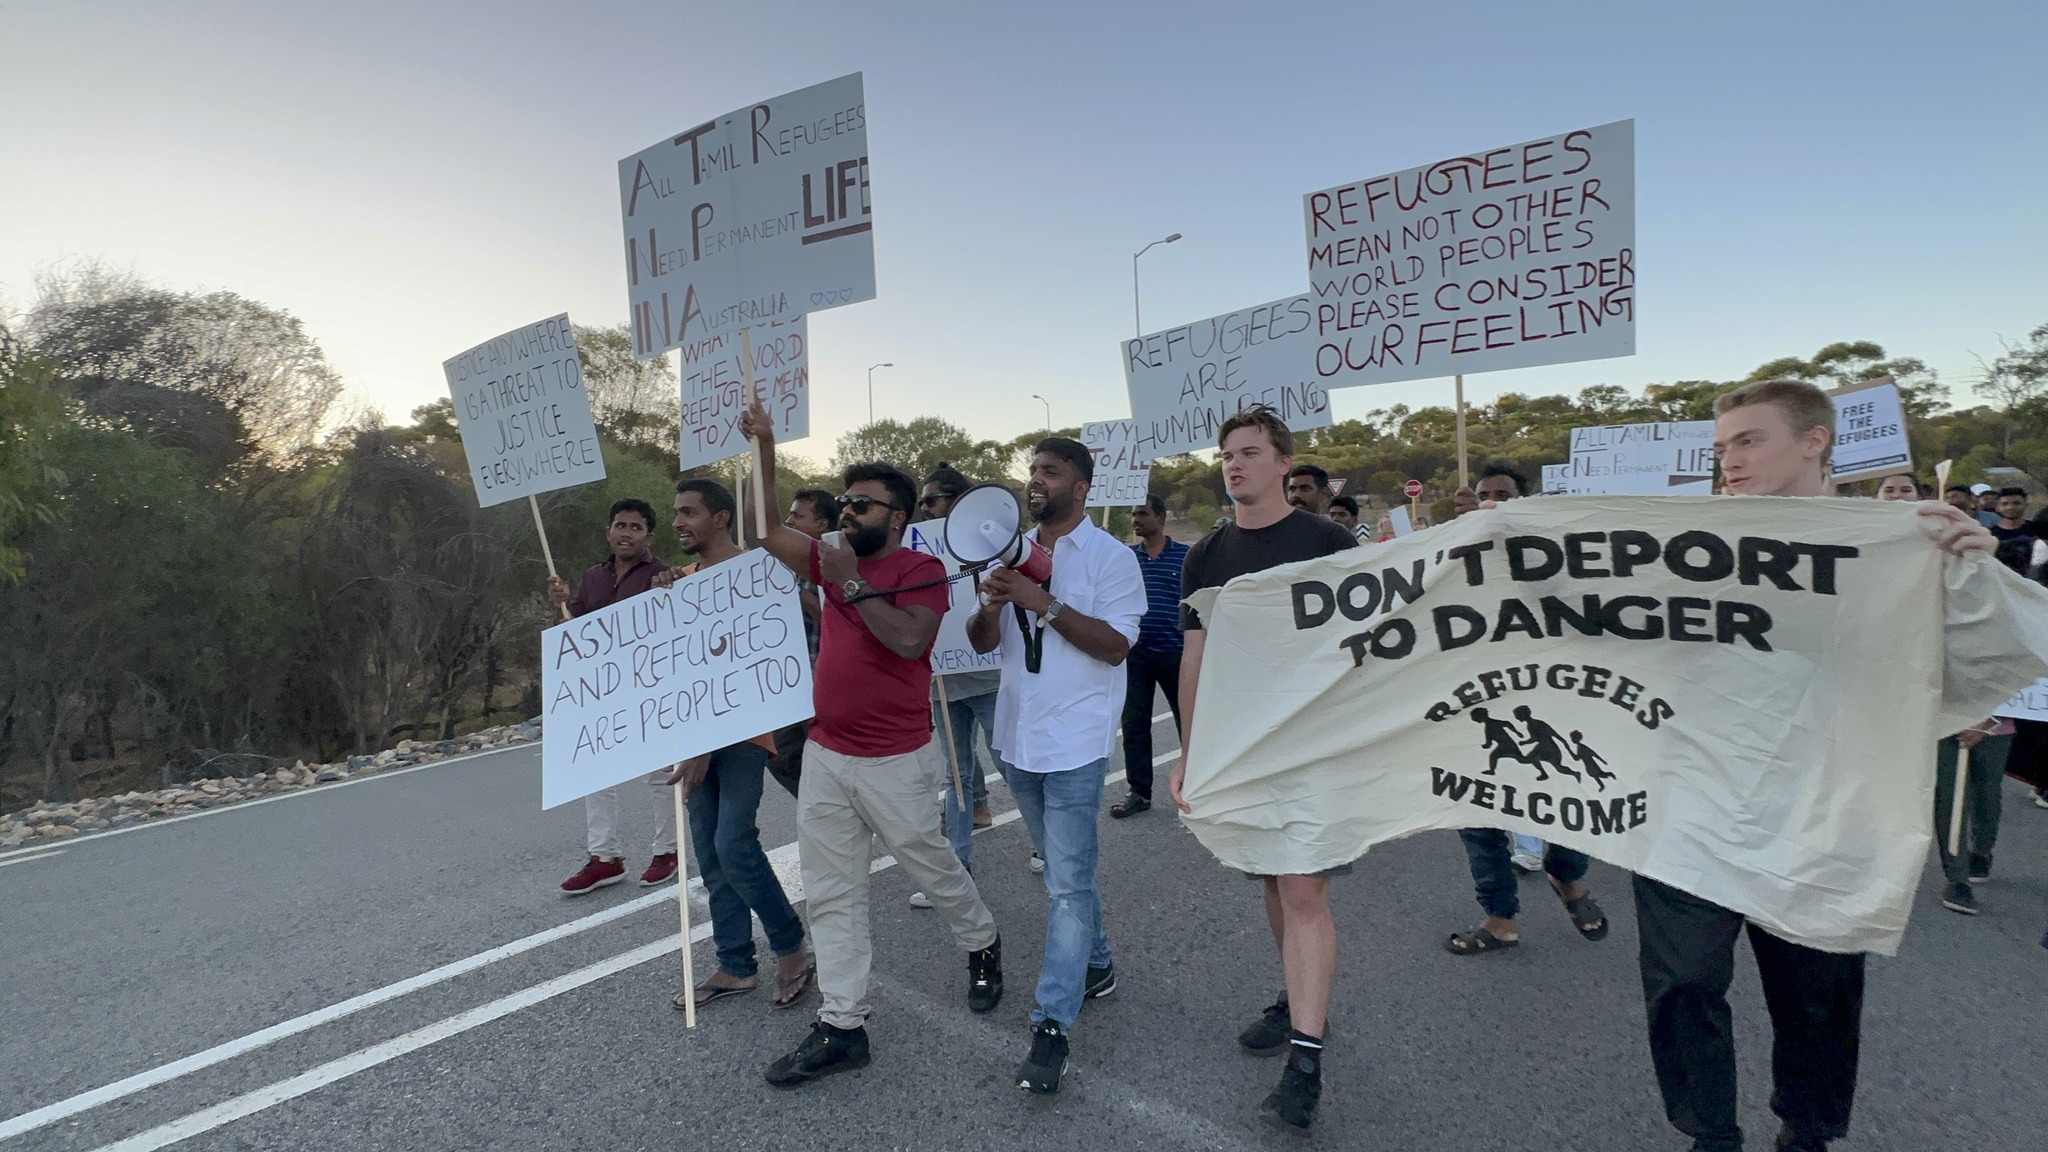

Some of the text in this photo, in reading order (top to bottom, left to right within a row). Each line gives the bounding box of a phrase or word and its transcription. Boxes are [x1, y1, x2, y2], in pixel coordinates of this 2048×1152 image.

[628, 159, 675, 216] ALL
[751, 104, 865, 164] REFUGEES
[1310, 130, 1592, 237] REFUGEES
[629, 156, 871, 286] NEED PERMANENT LIFE
[1310, 178, 1610, 271] MEAN NOT OTHER
[1312, 220, 1593, 297] WORLD PEOPLES
[1318, 248, 1634, 336] PLEASE CONSIDER
[488, 317, 573, 365] ANYWHERE
[634, 282, 790, 355] IN AUSTRALIA
[1128, 298, 1311, 373] REFUGEES
[1316, 285, 1633, 377] OUR FEELING
[487, 365, 546, 410] THREAT
[552, 358, 579, 391] TO
[686, 360, 728, 397] THE
[1178, 355, 1247, 404] ARE
[1842, 401, 1875, 419] FREE
[494, 404, 566, 455] JUSTICE
[692, 425, 718, 452] TO
[1086, 422, 1118, 444] SAY
[1135, 400, 1225, 453] HUMAN
[1574, 428, 1607, 449] ALL
[1604, 424, 1665, 444] TAMIL
[1834, 423, 1898, 446] EFUGEES
[1848, 415, 1873, 430] THE
[480, 437, 596, 489] EVERYWHERE
[1088, 474, 1148, 501] EFUGEES
[1573, 456, 1610, 478] NEED
[1677, 448, 1714, 472] LIFE
[1290, 529, 1859, 630] DON'T DEPORT
[551, 603, 788, 715] AND REFUGEES
[556, 592, 677, 670] ASYLUM
[1340, 594, 1775, 668] TO DANGER
[572, 655, 801, 764] ARE PEOPLE TOO
[1424, 663, 1675, 731] REFUGEES
[1430, 766, 1647, 836] WELCOME
